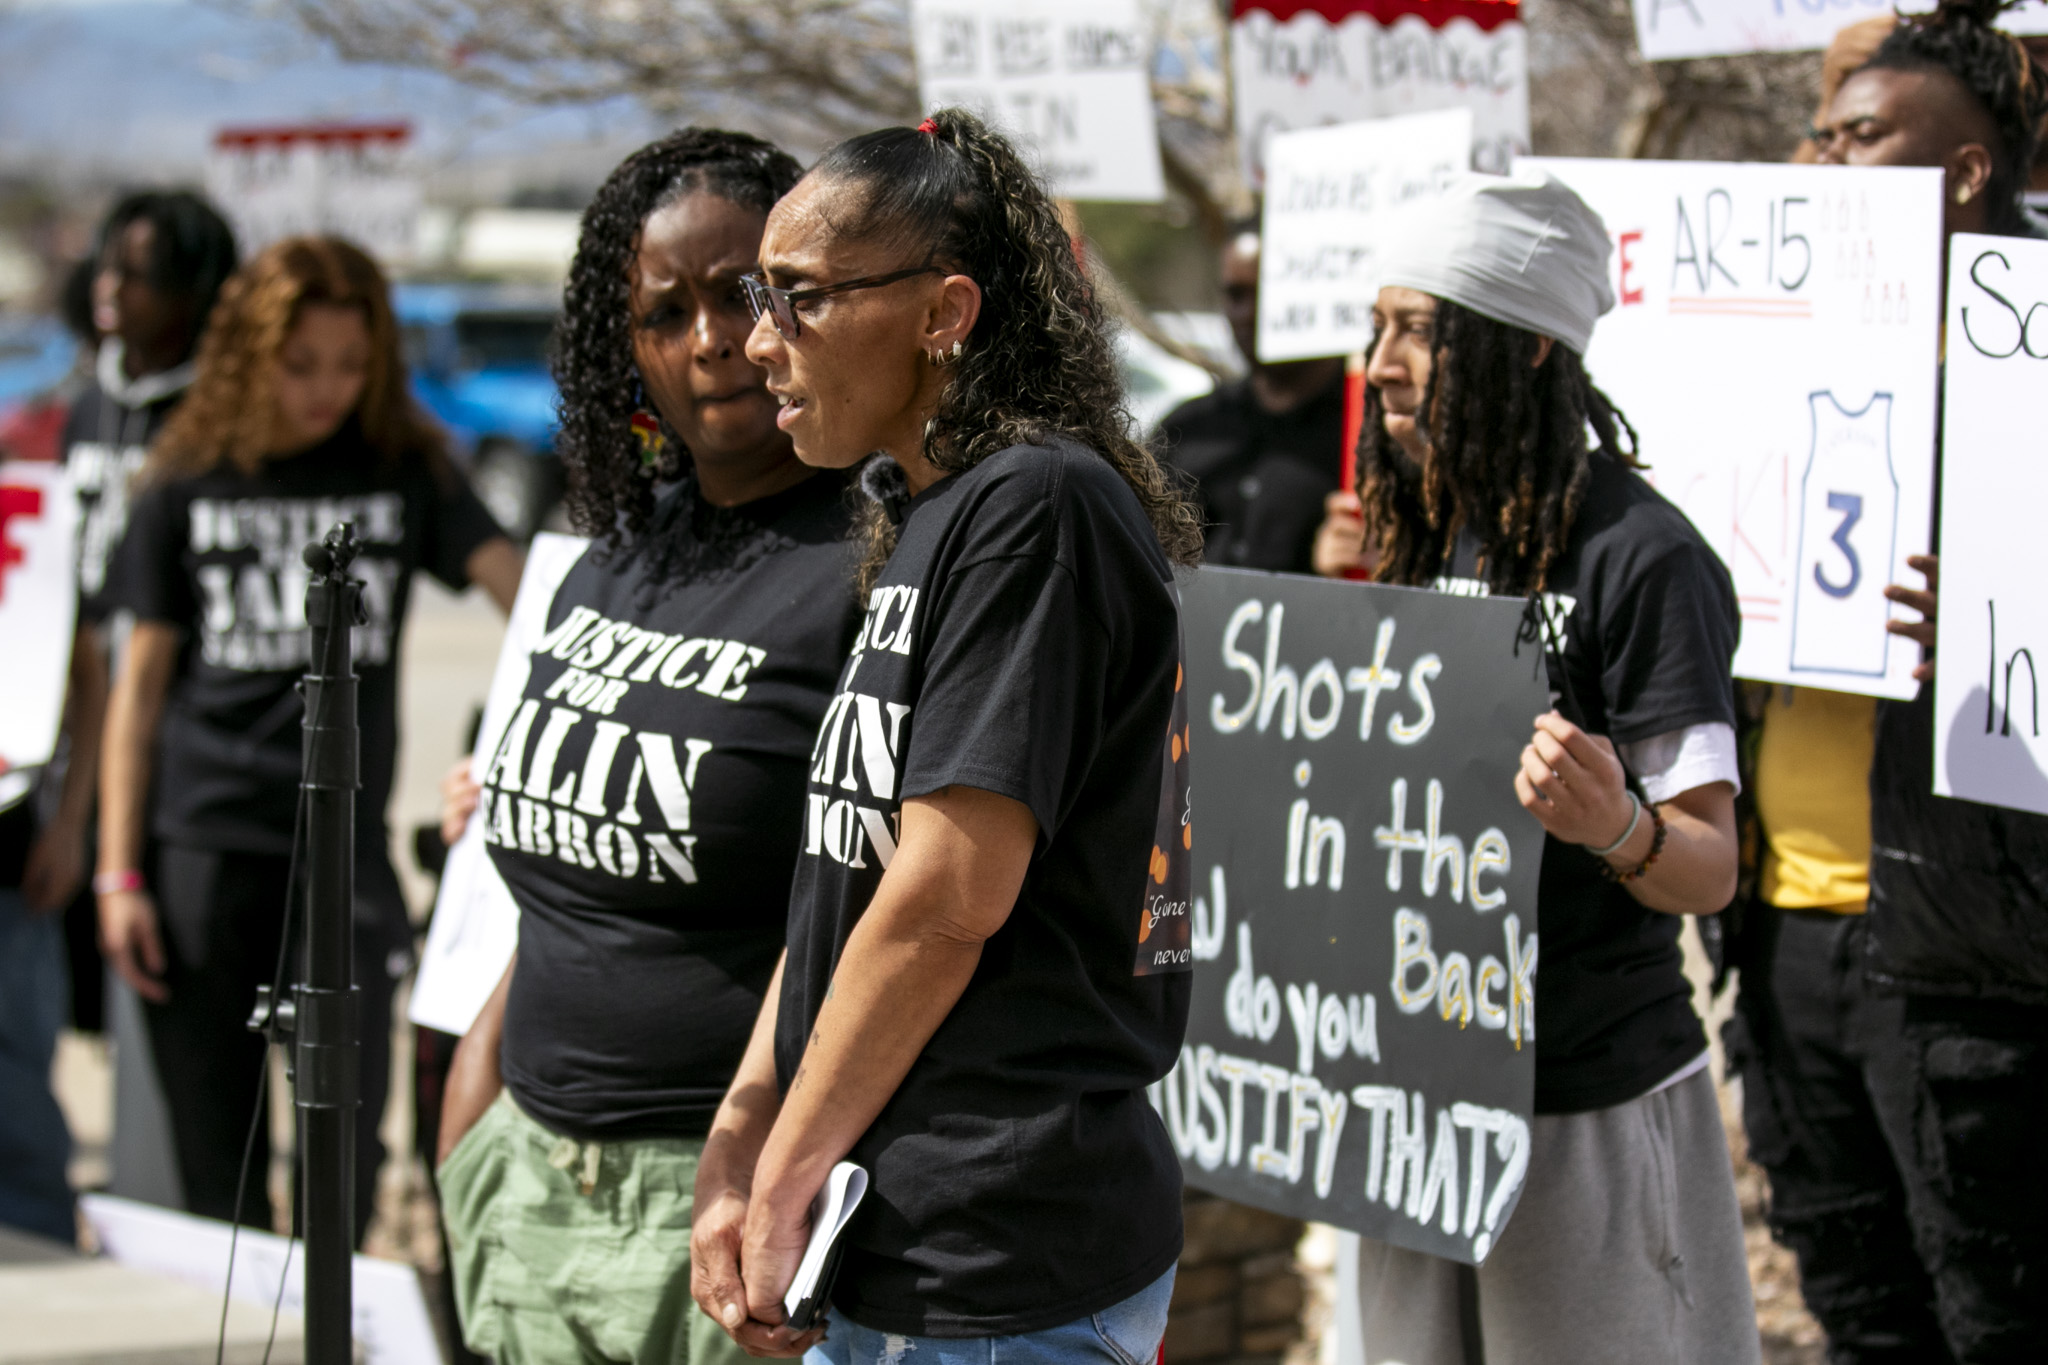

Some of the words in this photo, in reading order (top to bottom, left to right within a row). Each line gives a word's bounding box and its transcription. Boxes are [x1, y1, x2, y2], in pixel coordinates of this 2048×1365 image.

[1671, 187, 1812, 293] AR-15
[1814, 489, 1864, 601] 3
[534, 604, 767, 701] JUSTICE
[543, 666, 630, 716] FOR
[1210, 597, 1444, 745] Shots
[1984, 598, 2041, 738] In
[487, 698, 714, 831] ALIN
[484, 788, 699, 885] ABRON
[1283, 758, 1347, 893] in
[1373, 776, 1512, 913] the
[1225, 920, 1282, 1044] do
[1285, 981, 1382, 1076] you
[1390, 906, 1540, 1052] Back
[1351, 1084, 1532, 1264] THAT?
